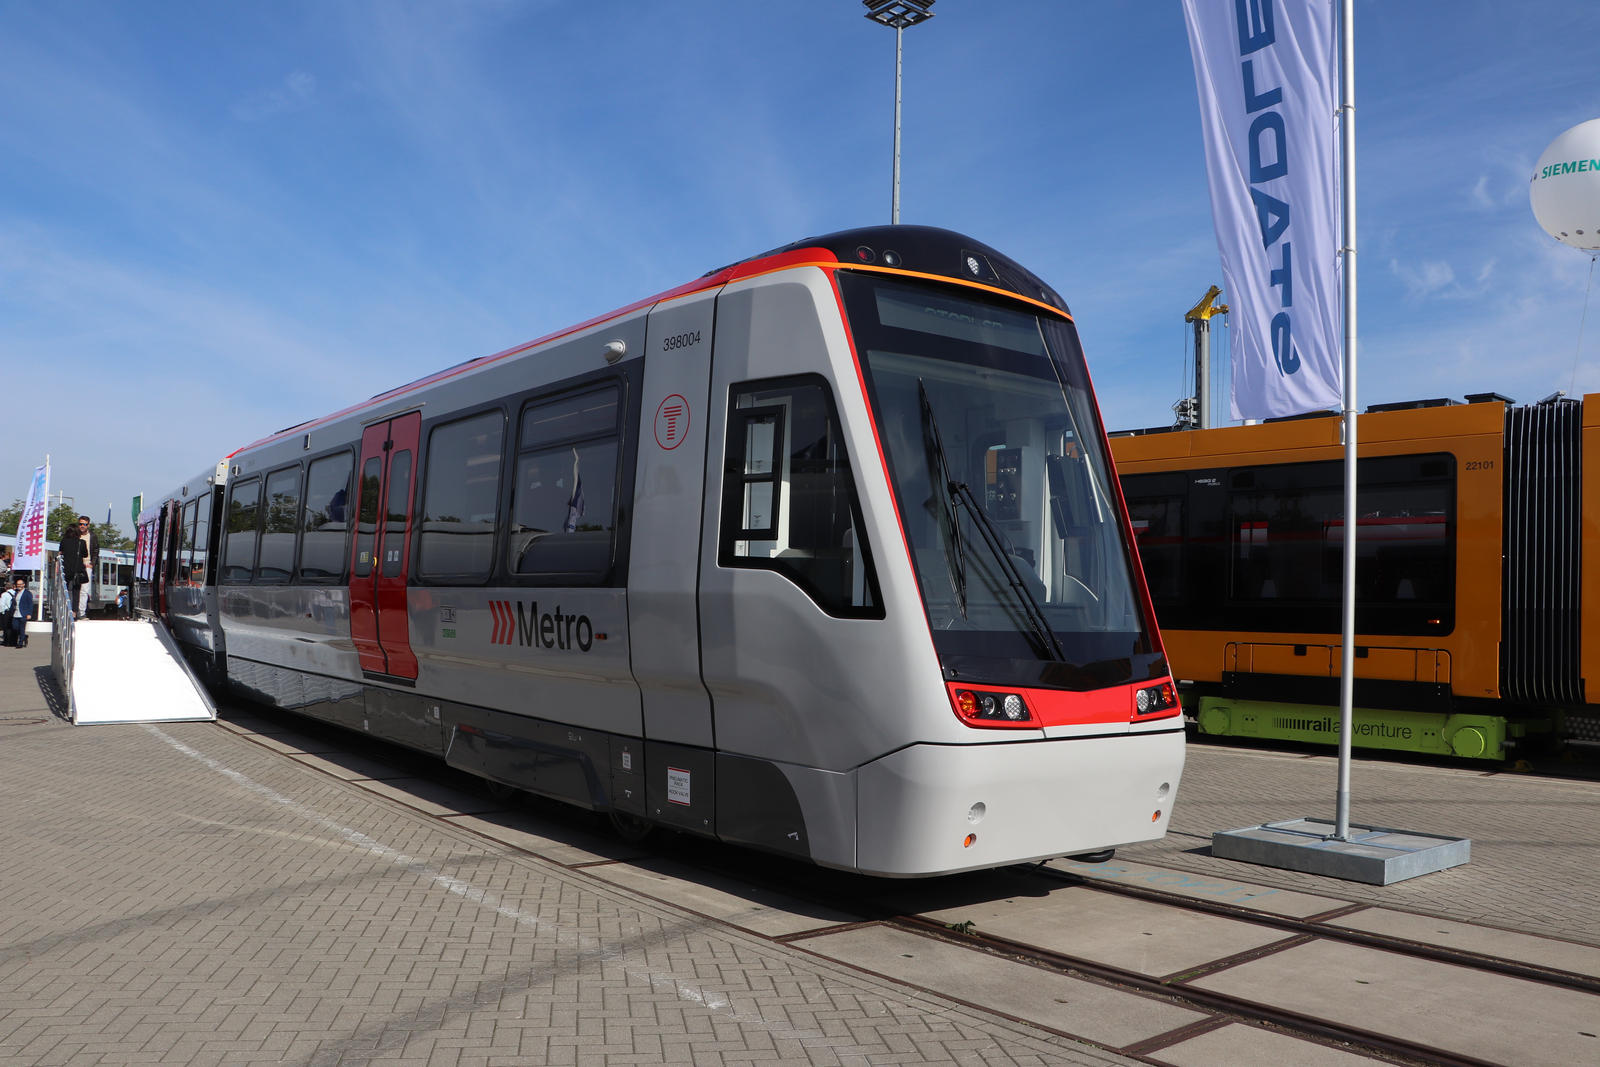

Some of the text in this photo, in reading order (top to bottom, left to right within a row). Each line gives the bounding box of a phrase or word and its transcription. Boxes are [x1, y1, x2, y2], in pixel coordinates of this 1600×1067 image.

[663, 330, 701, 352] 398004
[1465, 460, 1495, 471] 22101
[517, 600, 593, 653] Metro
